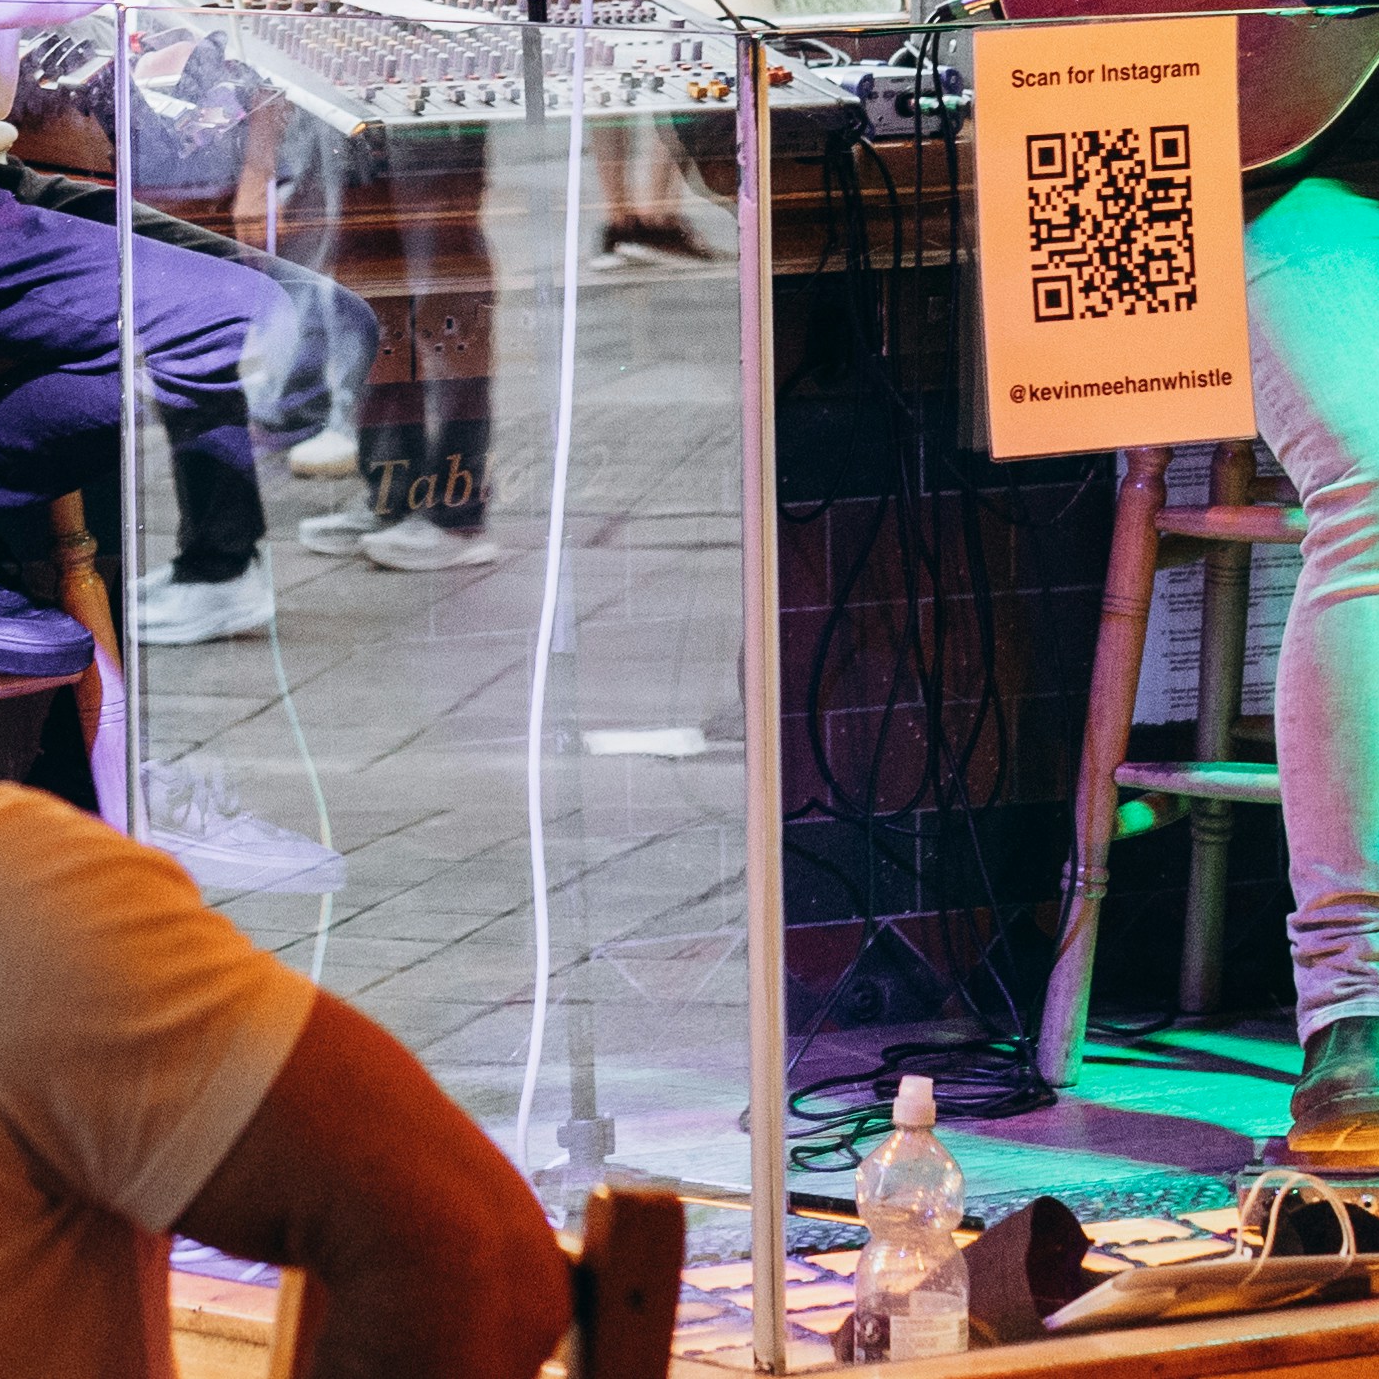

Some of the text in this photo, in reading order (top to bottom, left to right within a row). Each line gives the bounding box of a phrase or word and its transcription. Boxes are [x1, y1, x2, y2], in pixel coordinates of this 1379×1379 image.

[1010, 60, 1201, 89] Scan for Instagram
[1009, 366, 1233, 405] @kevinmeehanwhistle
